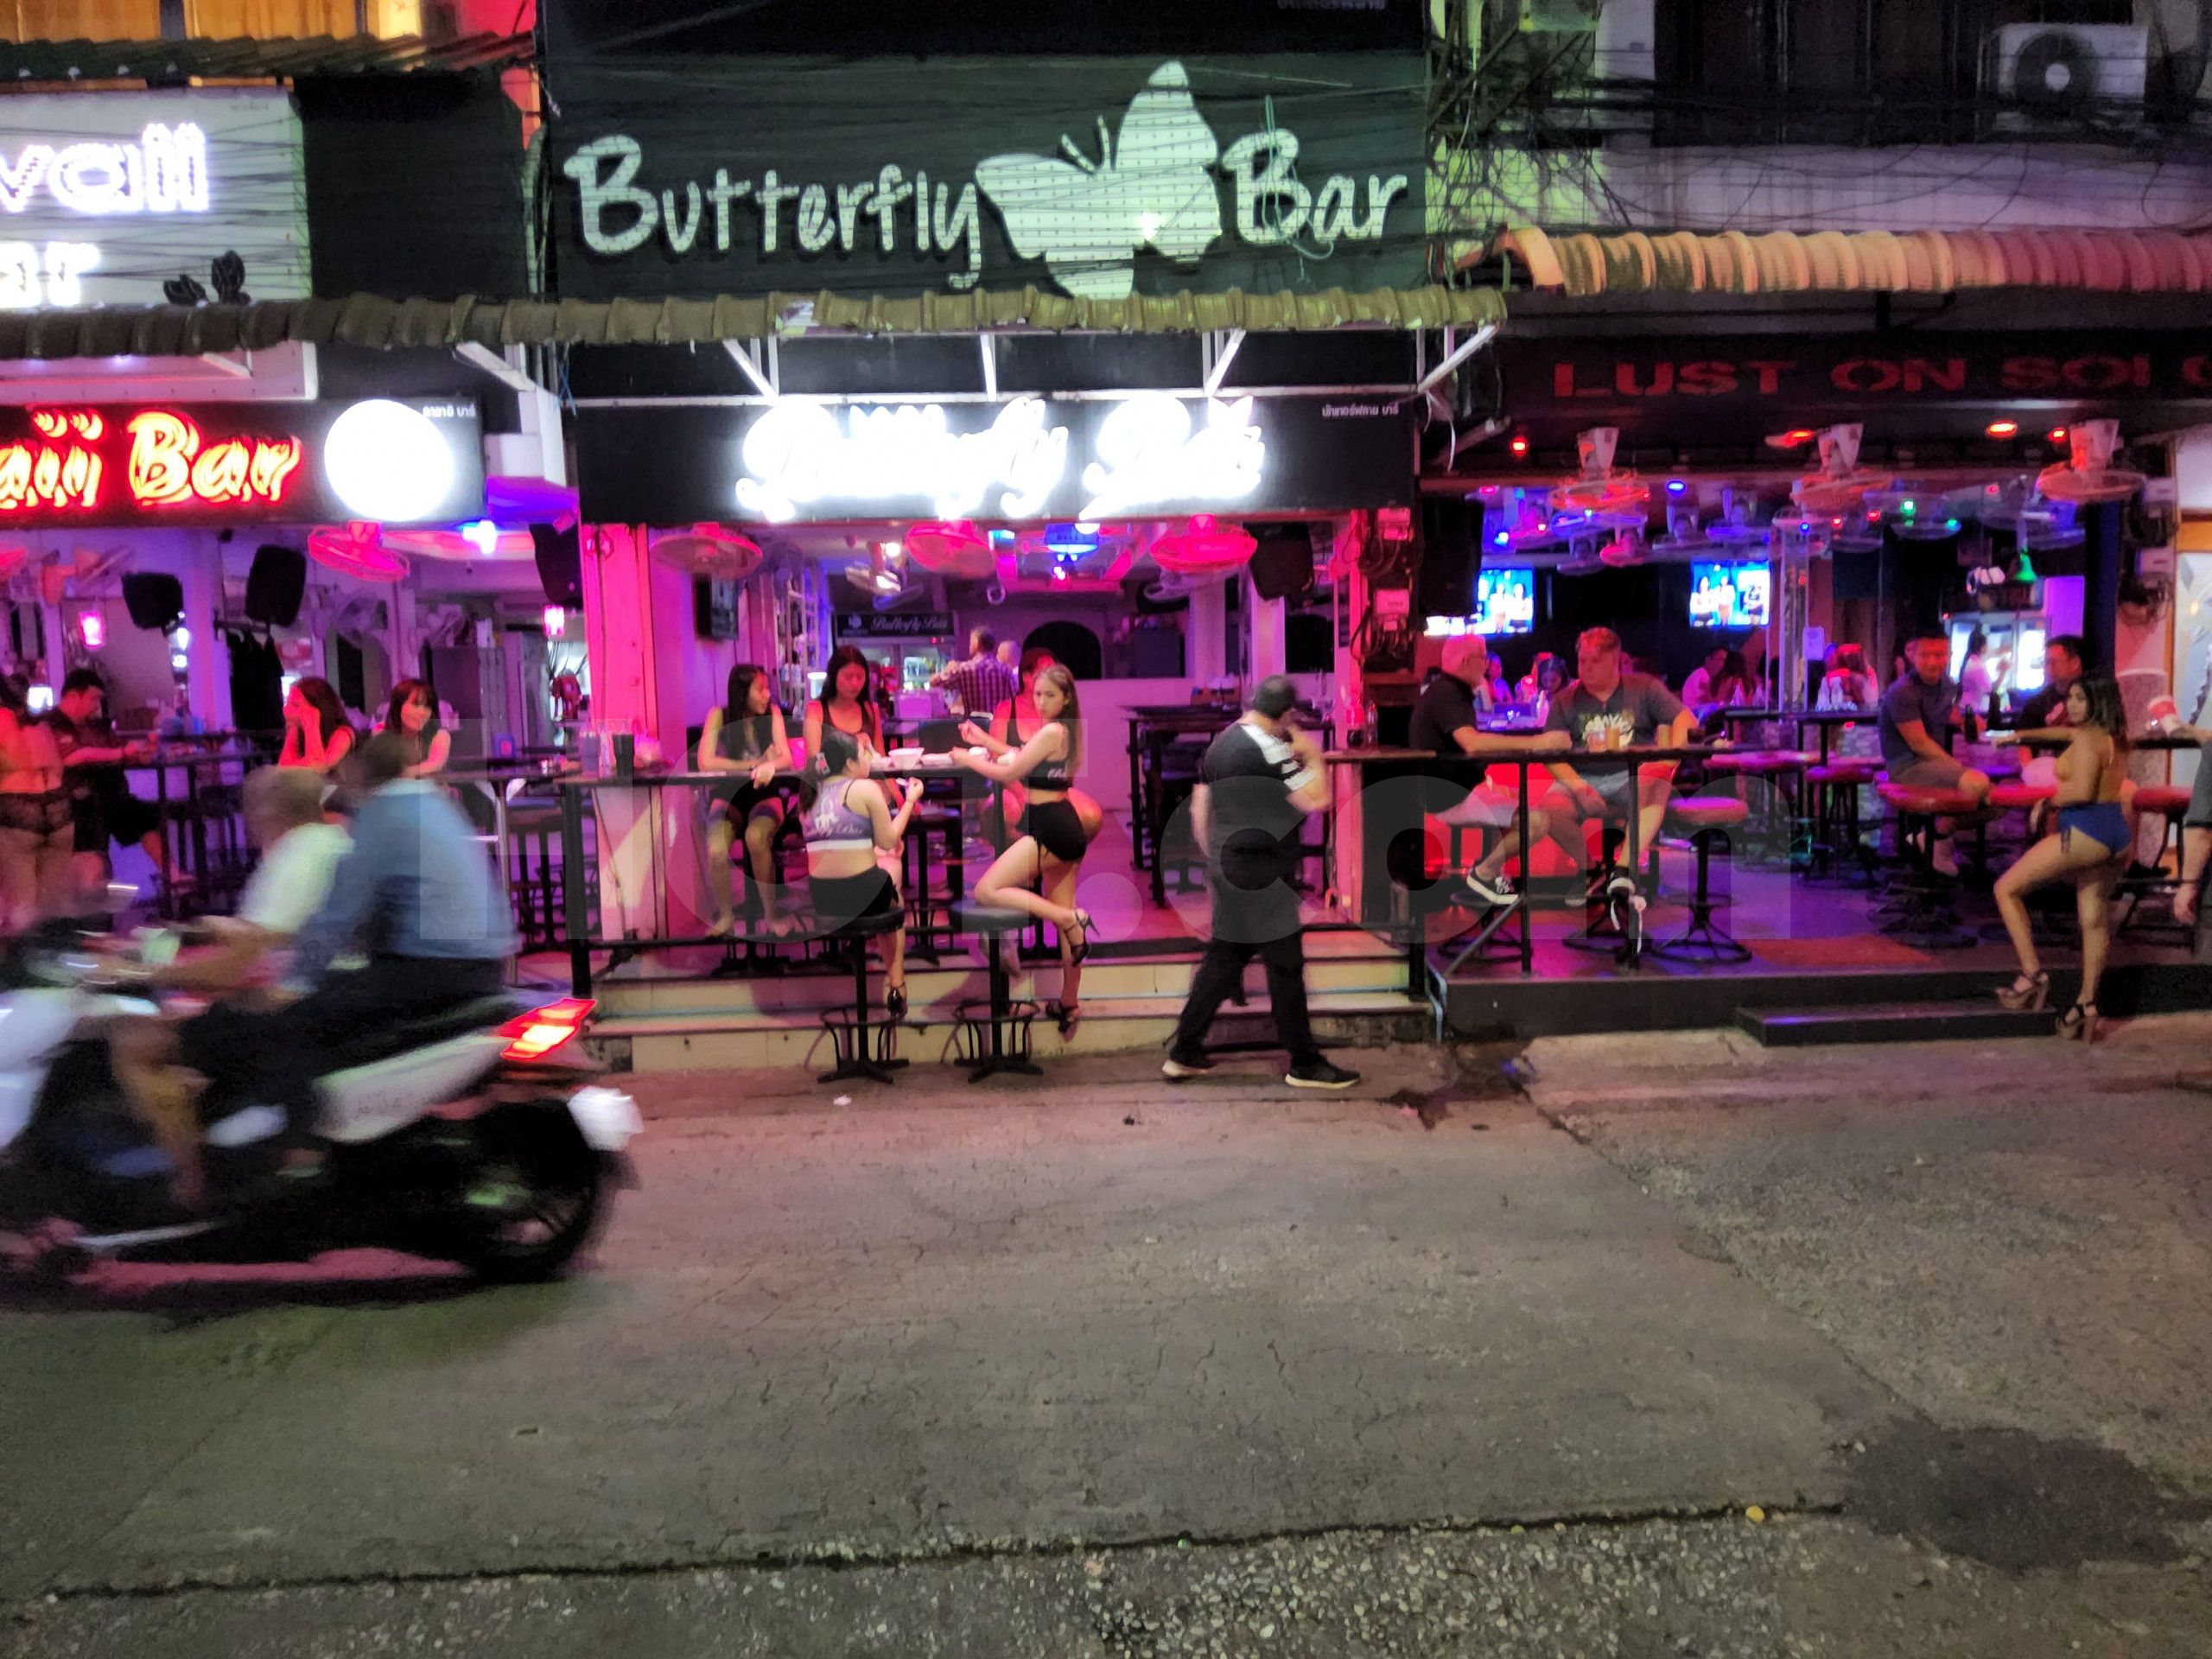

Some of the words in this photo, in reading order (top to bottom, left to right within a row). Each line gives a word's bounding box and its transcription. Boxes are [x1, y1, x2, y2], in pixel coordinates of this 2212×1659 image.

[563, 134, 982, 289] Butterfly
[1223, 129, 1408, 244] Bar
[1554, 359, 1798, 397] LUST
[1830, 357, 1967, 392] ON
[2000, 353, 2152, 390] SOI
[127, 410, 301, 507] Bar
